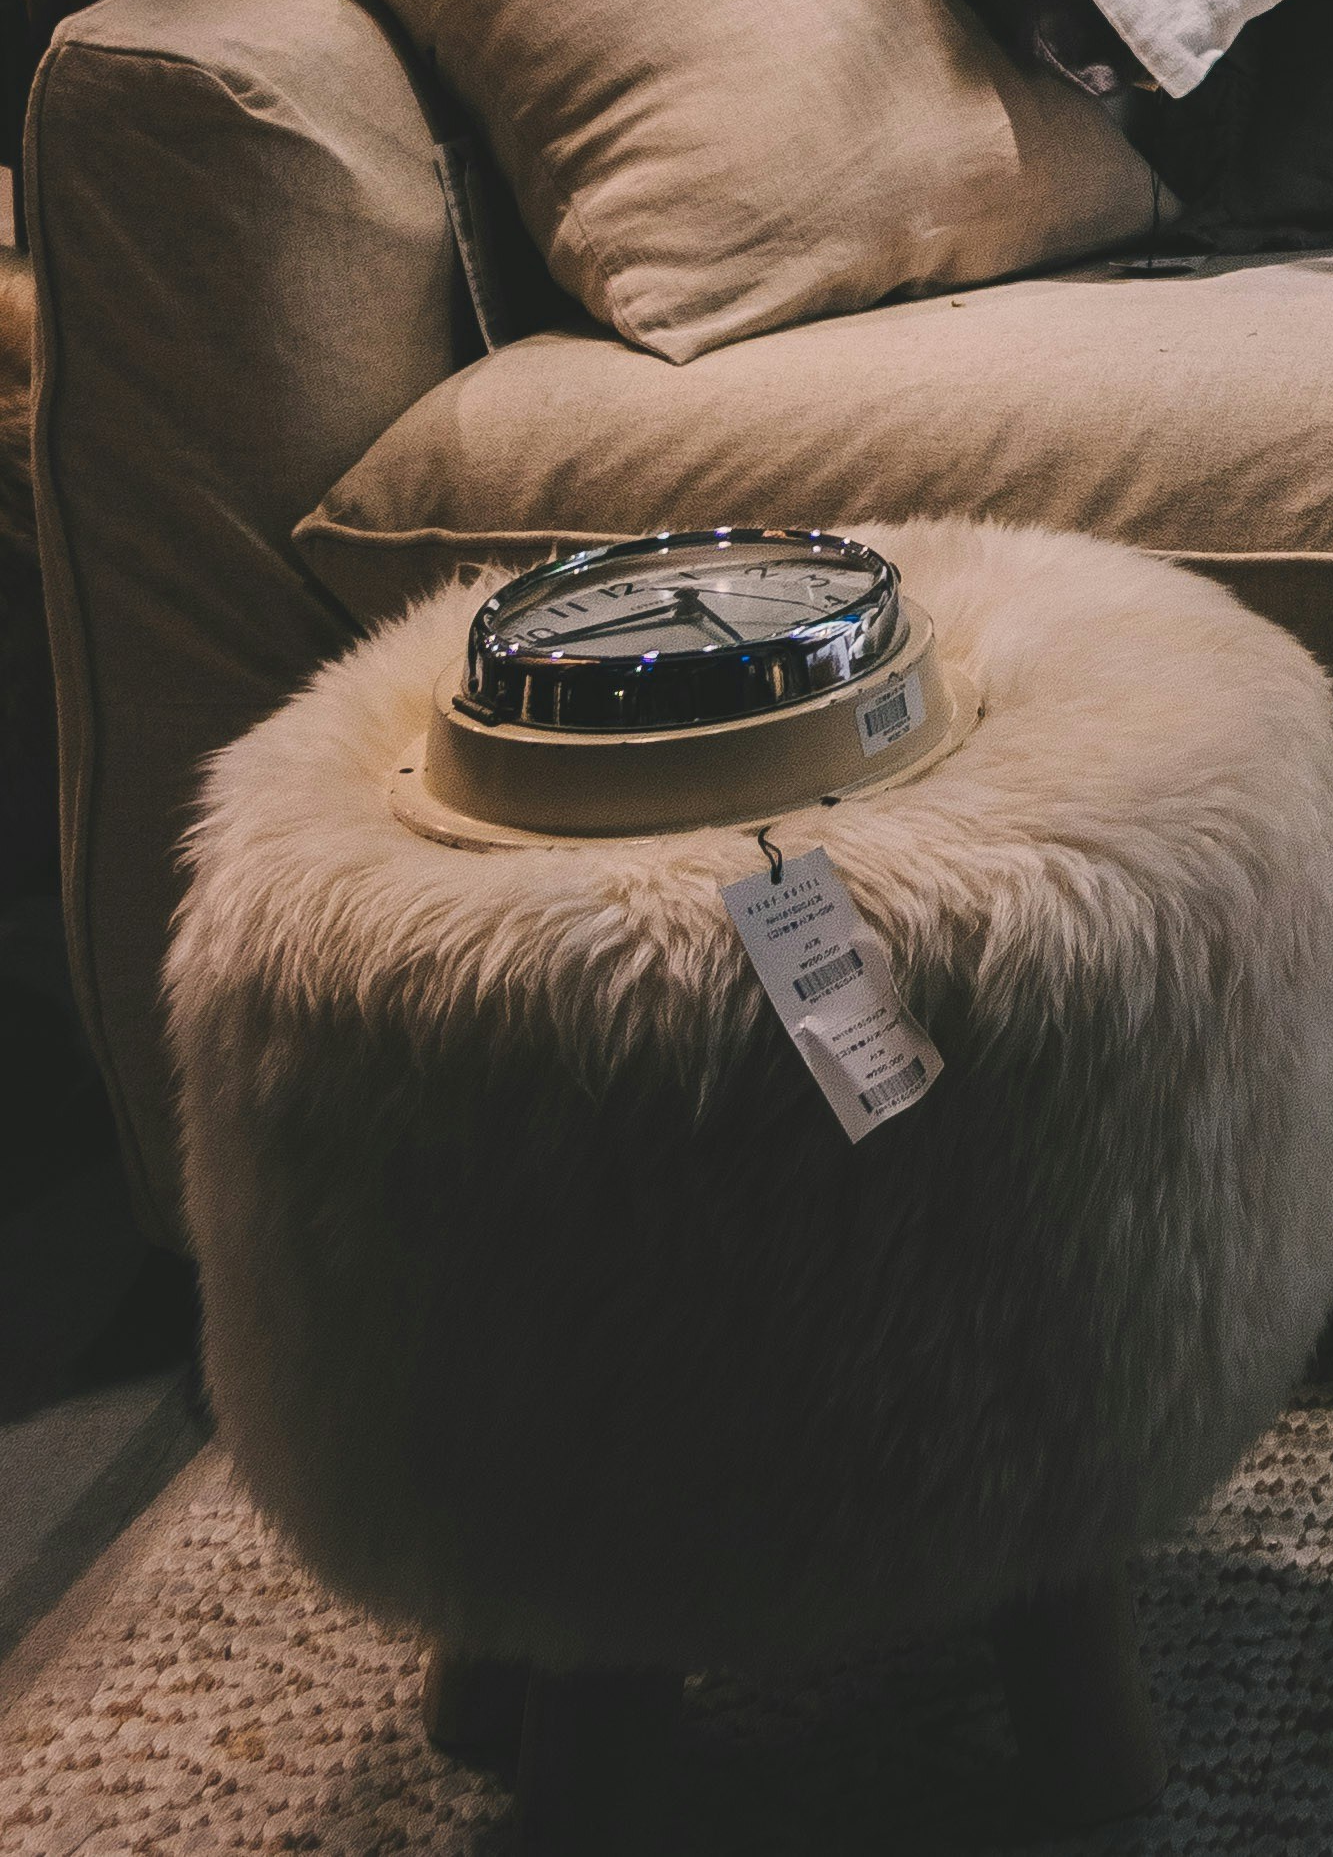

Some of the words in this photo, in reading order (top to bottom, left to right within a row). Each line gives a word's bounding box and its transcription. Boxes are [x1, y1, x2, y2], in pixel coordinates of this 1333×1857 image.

[744, 566, 779, 581] 2
[801, 574, 831, 588] 3
[598, 582, 646, 599] 12
[547, 601, 590, 619] 11
